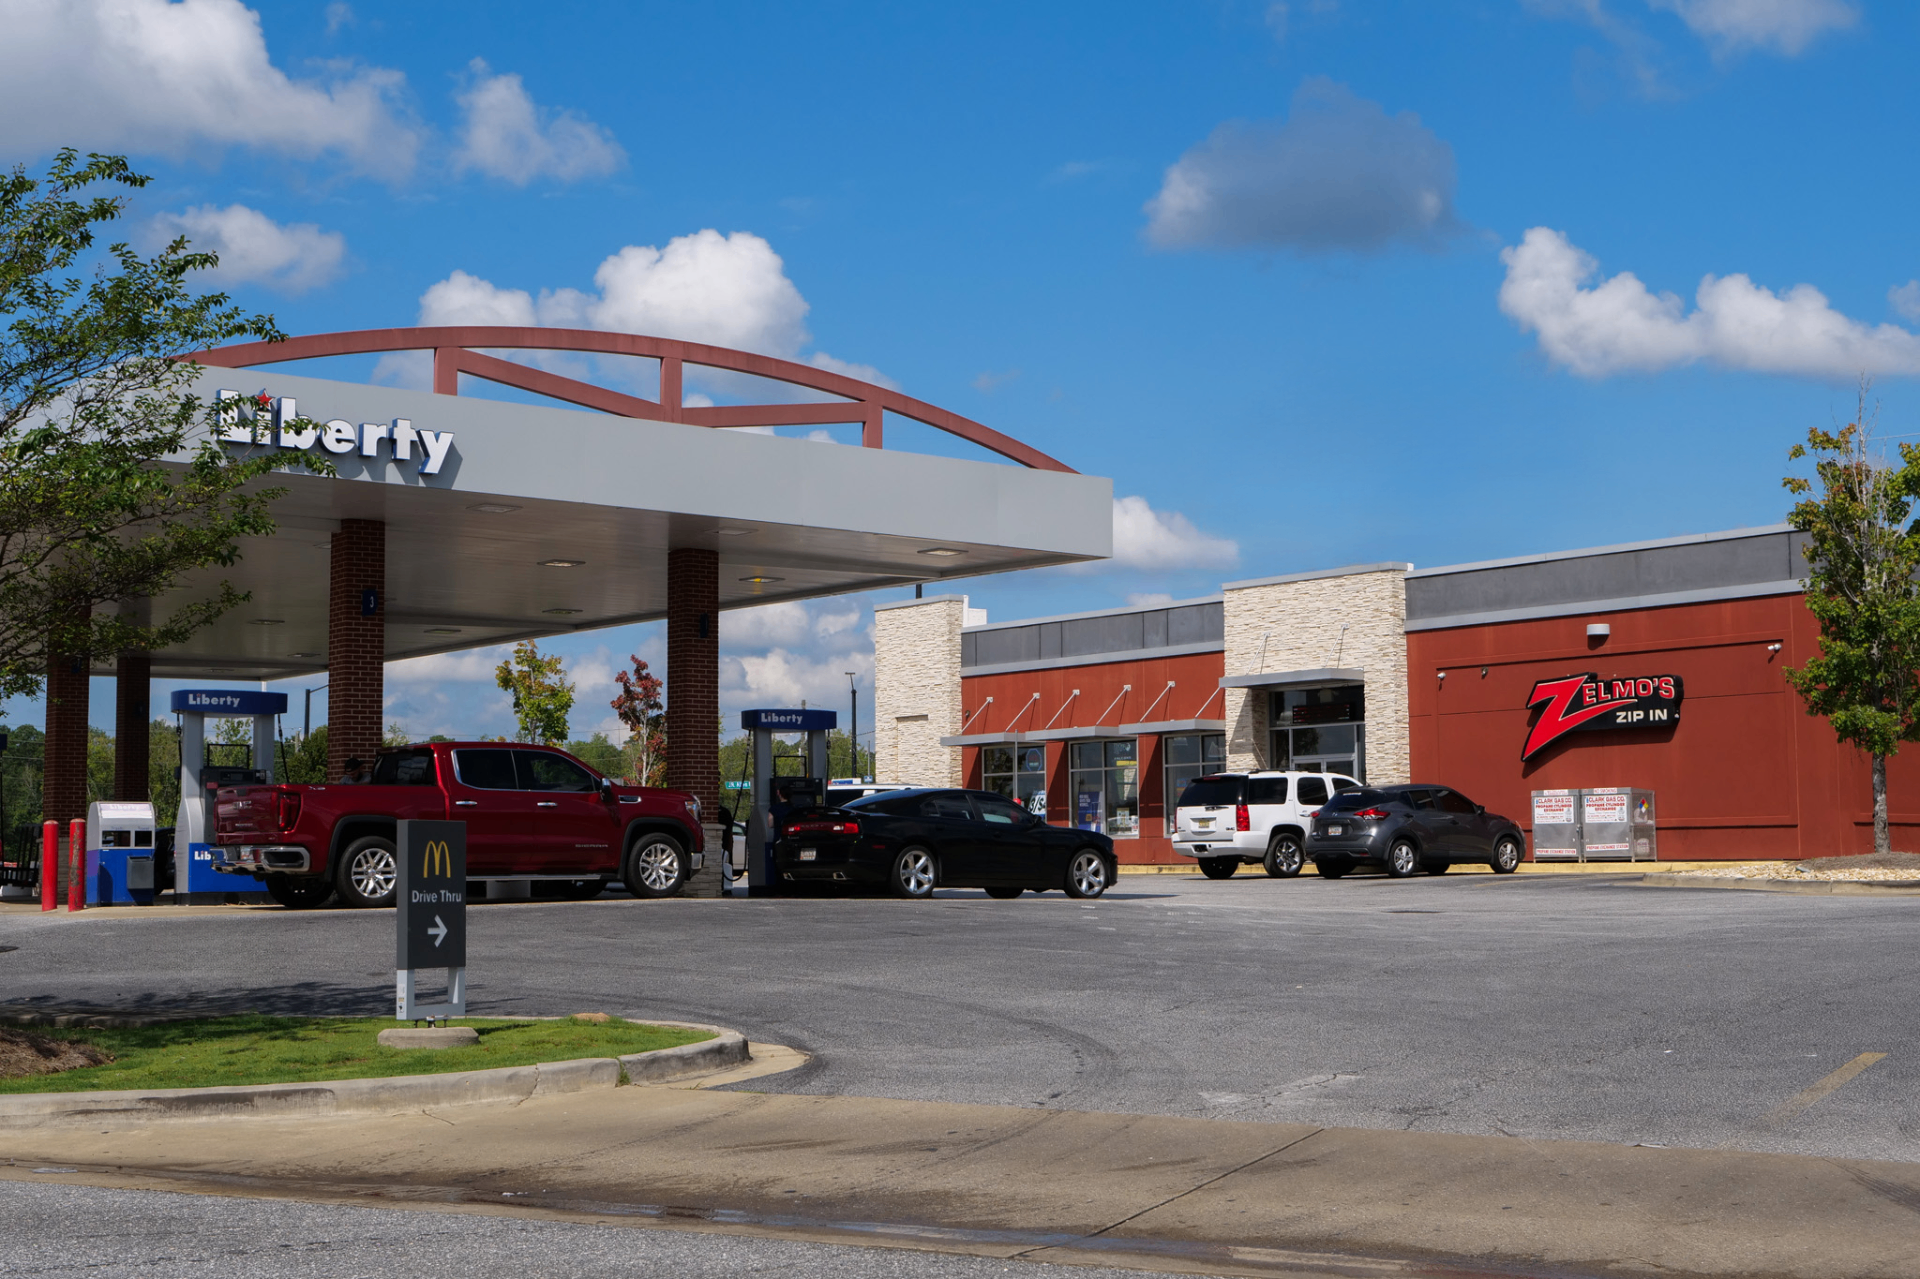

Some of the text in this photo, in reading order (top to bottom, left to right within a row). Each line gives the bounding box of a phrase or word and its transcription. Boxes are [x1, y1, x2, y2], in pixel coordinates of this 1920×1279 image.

[215, 388, 455, 475] Liberty
[188, 693, 240, 708] Liberty
[761, 712, 803, 725] Liberty
[1523, 675, 1675, 761] ZELMO'S
[1616, 709, 1668, 723] ZIP IN
[411, 889, 462, 903] Drive Thru
